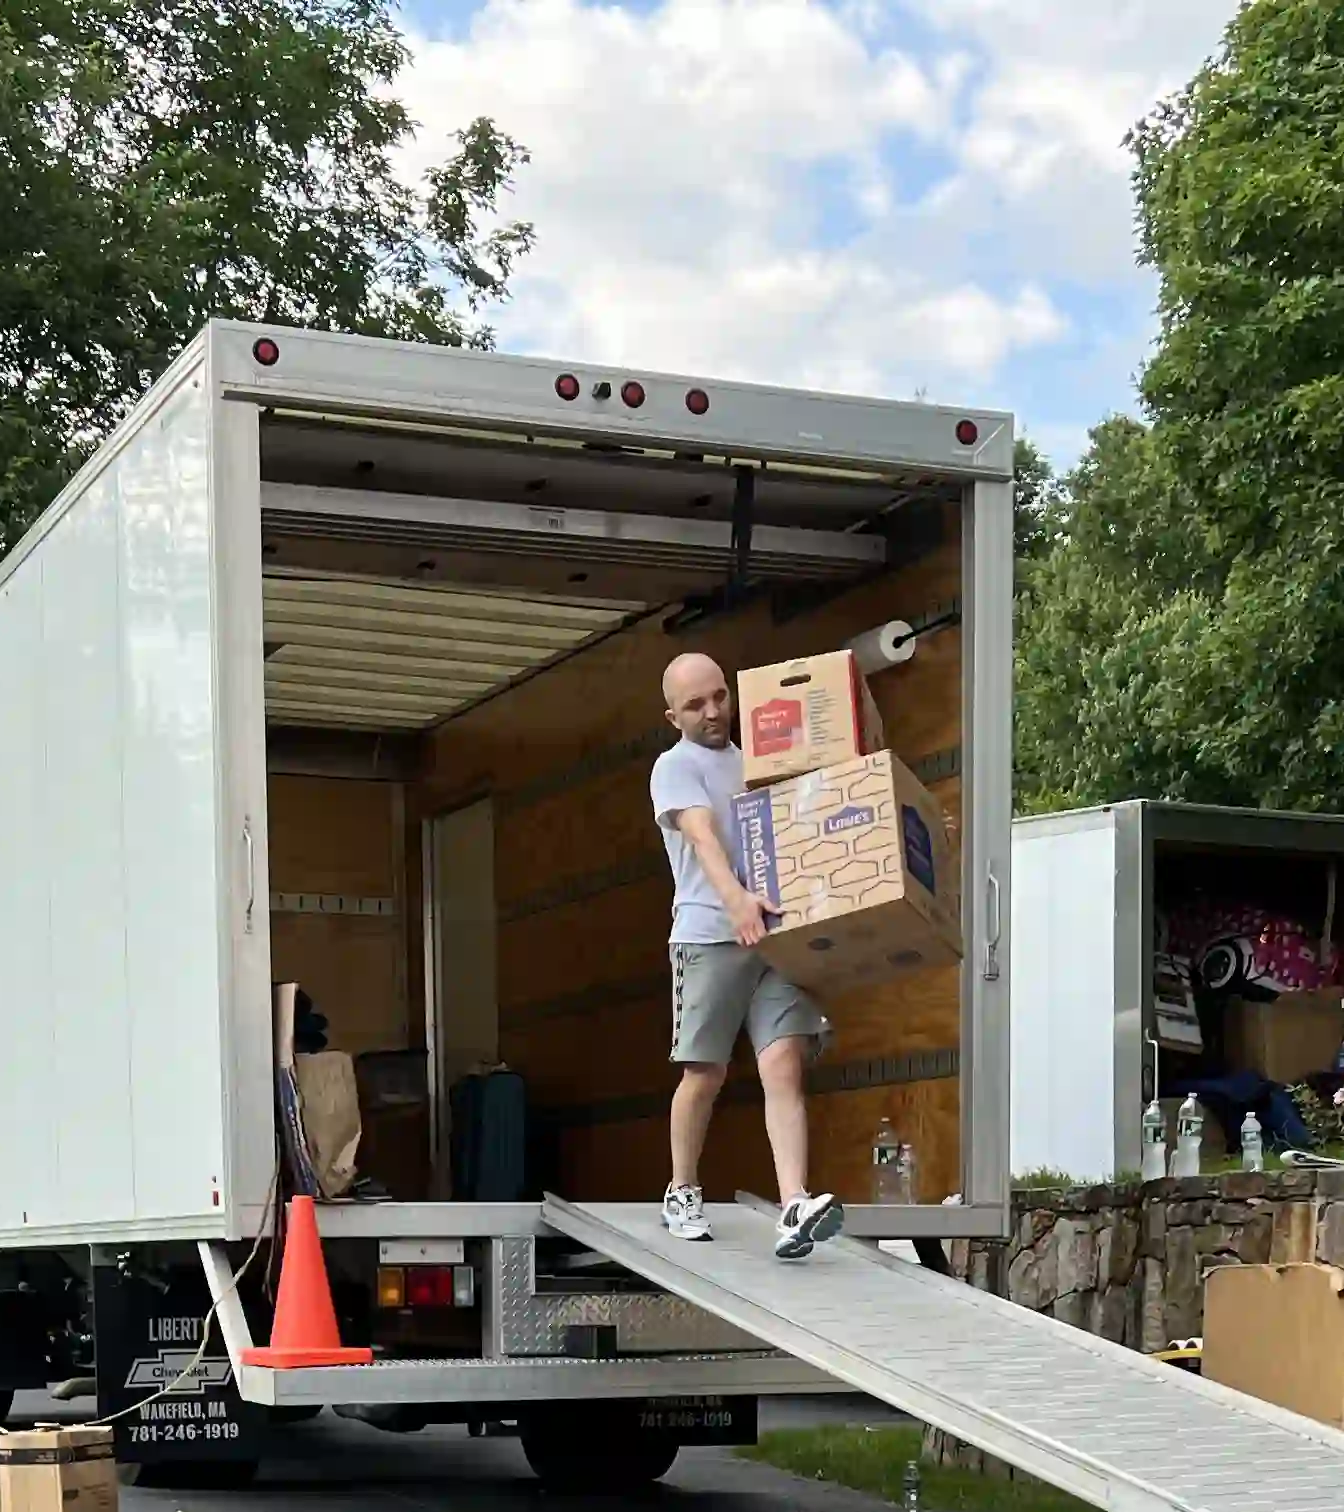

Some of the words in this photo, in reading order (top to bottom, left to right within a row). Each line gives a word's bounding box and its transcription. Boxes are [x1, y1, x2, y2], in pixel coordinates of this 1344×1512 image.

[152, 1366, 209, 1378] Chevlet
[140, 1402, 206, 1420] WAKEFIELD,
[208, 1401, 227, 1418] MA
[128, 1422, 239, 1442] 781-246-1919
